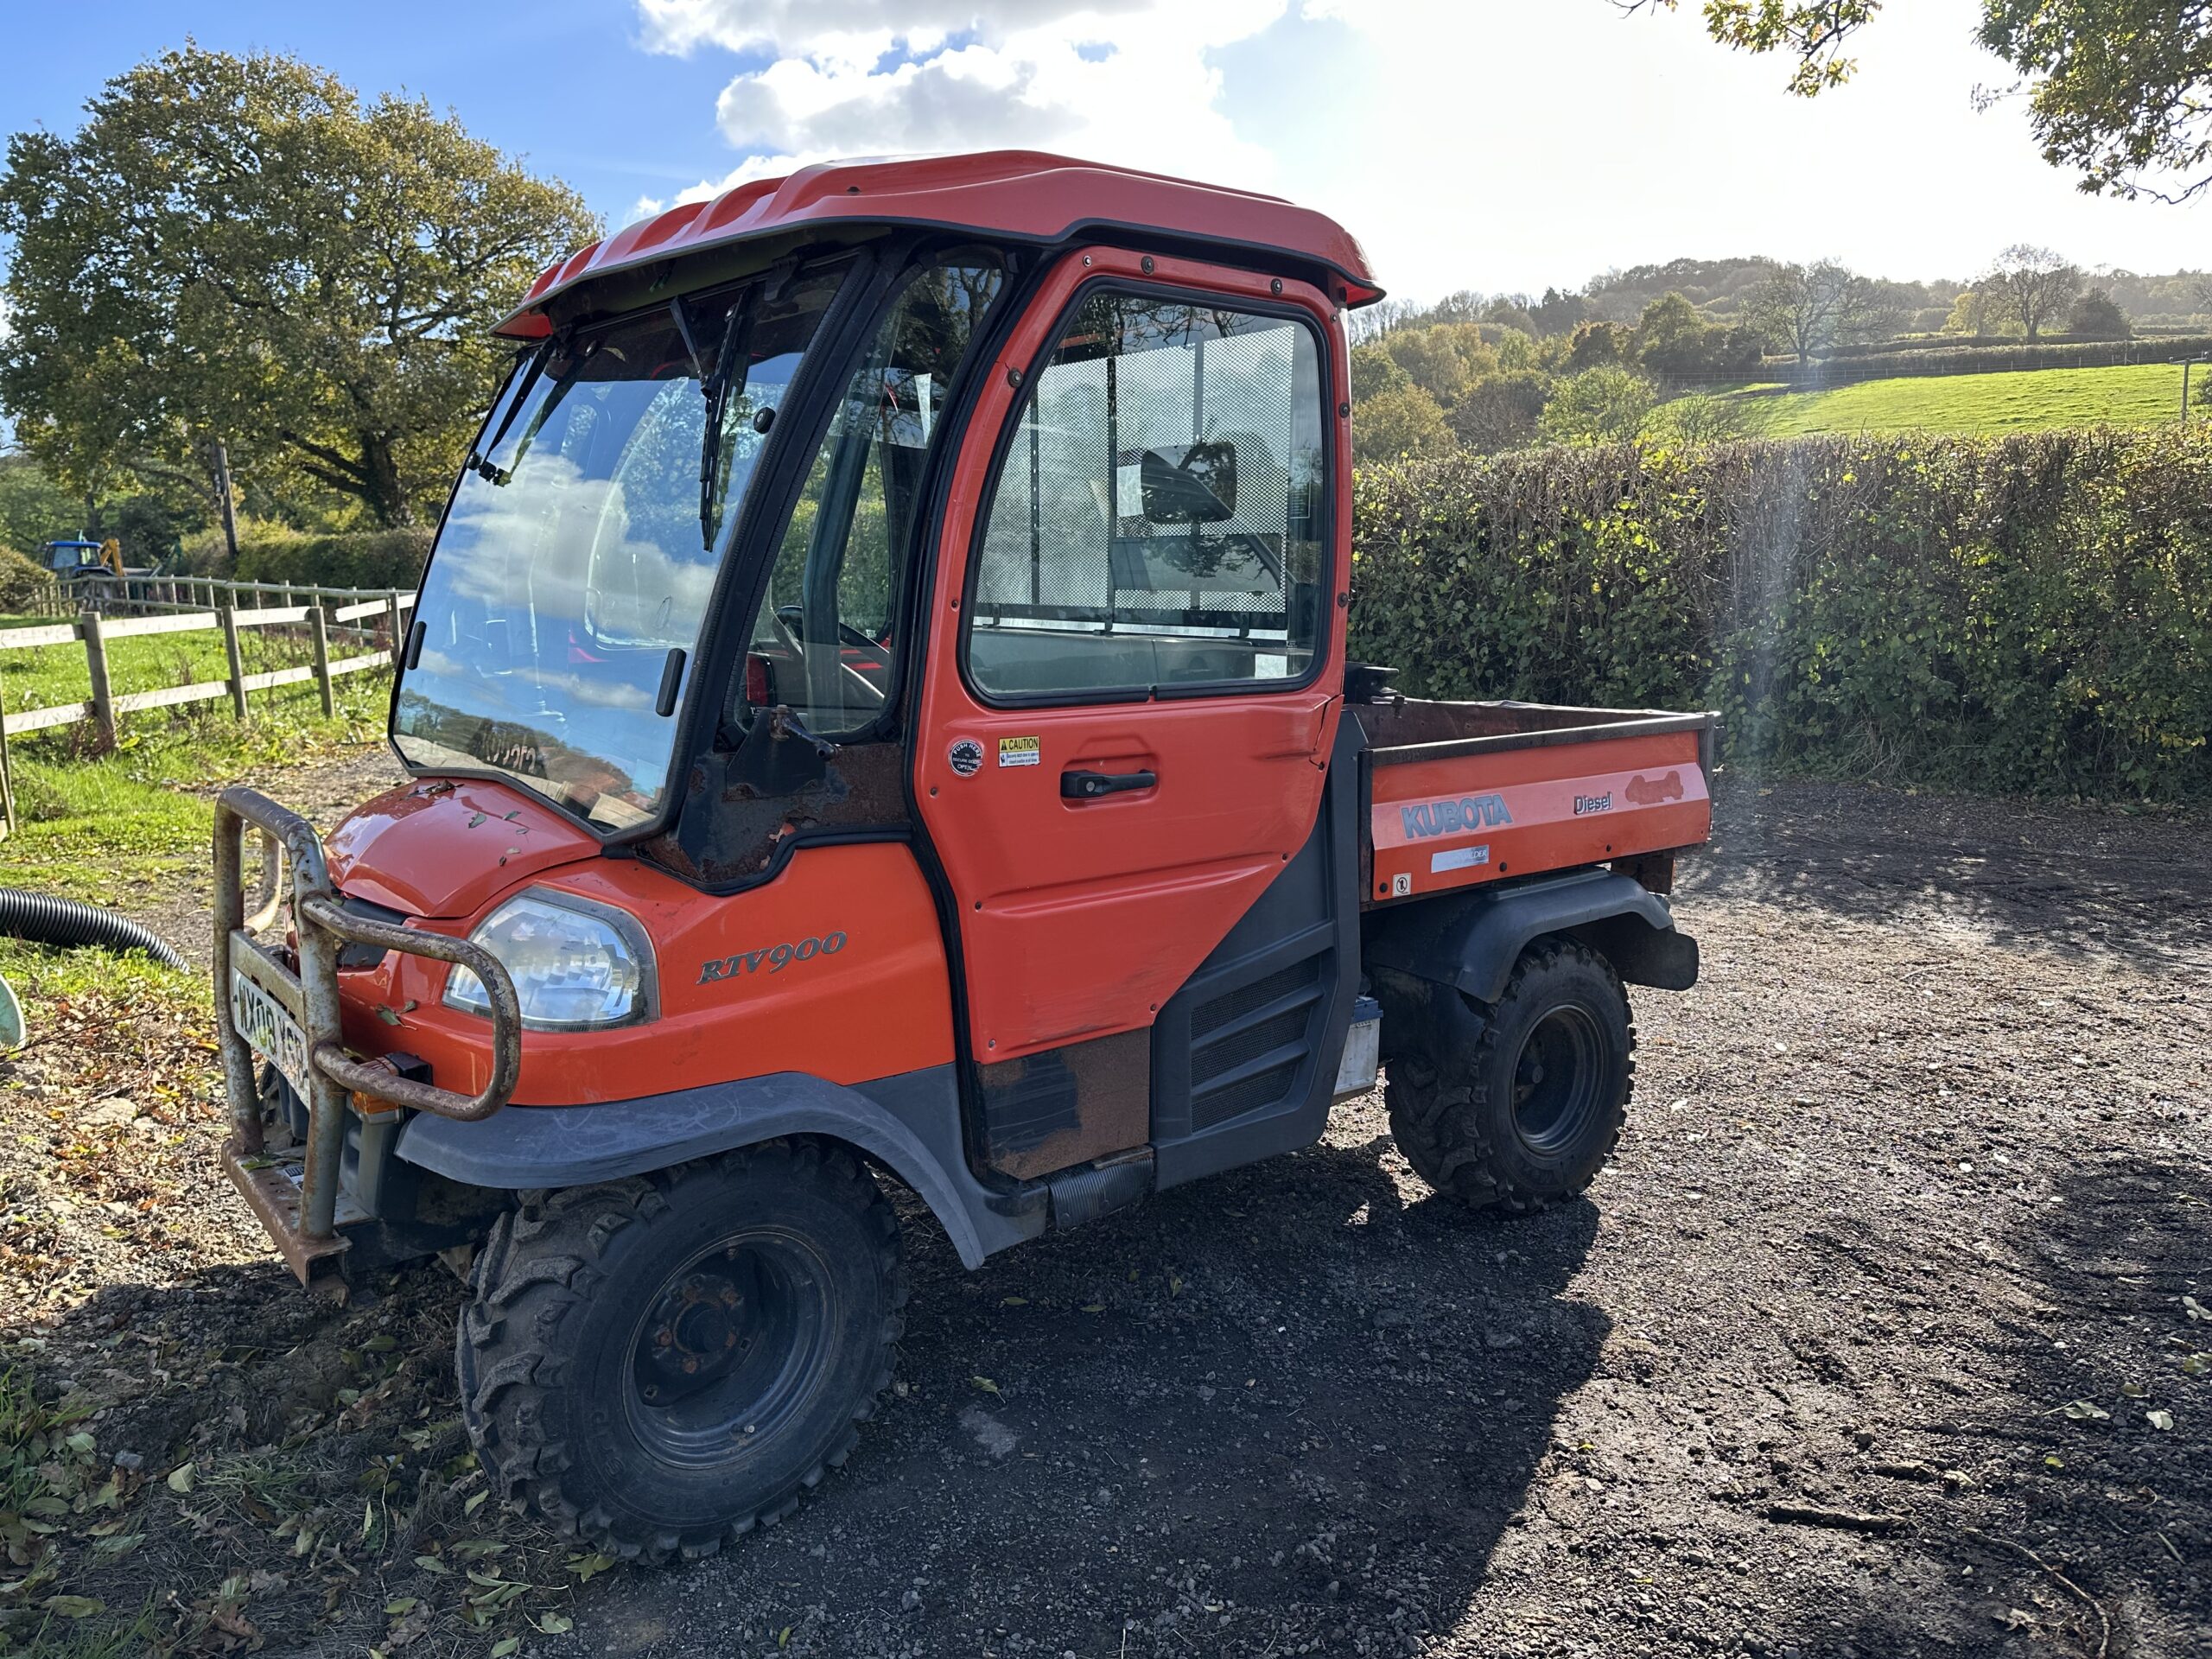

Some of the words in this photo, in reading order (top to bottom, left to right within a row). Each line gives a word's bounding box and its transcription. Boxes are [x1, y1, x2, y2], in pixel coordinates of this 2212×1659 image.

[953, 743, 968, 755] PUSH
[969, 743, 982, 758] HERE
[1008, 738, 1039, 750] CAUTION
[1573, 791, 1613, 816] Diesel
[1402, 793, 1514, 841] KUBOTA
[696, 931, 848, 986] RTV900
